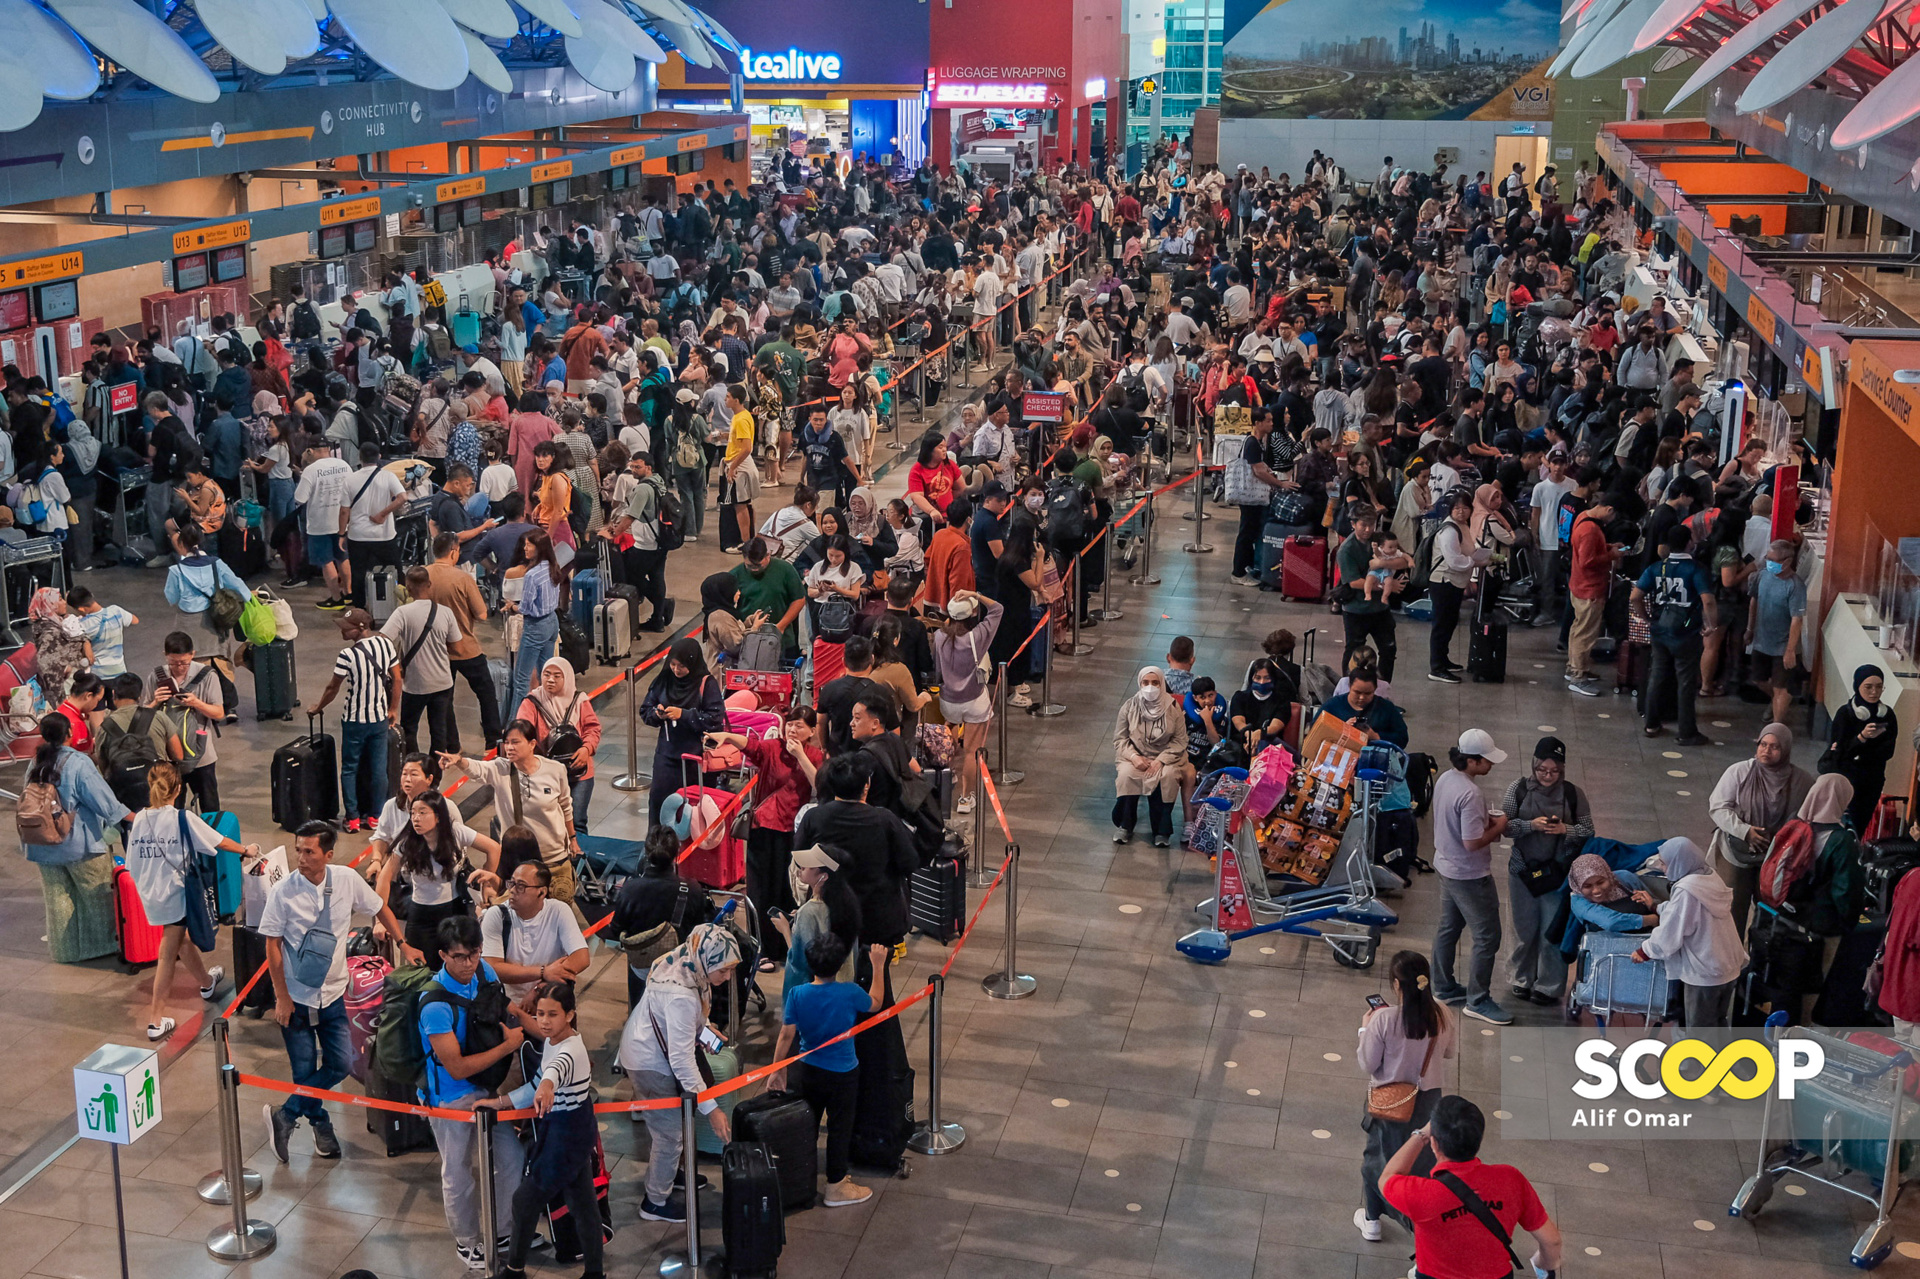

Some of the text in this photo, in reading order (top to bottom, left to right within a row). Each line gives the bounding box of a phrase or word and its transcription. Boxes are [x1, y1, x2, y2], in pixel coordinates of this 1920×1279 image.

[740, 48, 841, 80] tealive
[939, 66, 1066, 79] LUGGAGE WRAPPING
[1513, 87, 1550, 101] VGI
[338, 101, 409, 121] CONNECTIVITY
[366, 122, 386, 137] HUB
[366, 200, 379, 212] U10
[322, 209, 334, 221] U11
[233, 224, 248, 237] U12
[175, 235, 191, 249] U13
[61, 256, 79, 271] U14
[118, 389, 128, 397] NO
[1861, 356, 1912, 425] Service Counter
[114, 395, 133, 406] ENTRY
